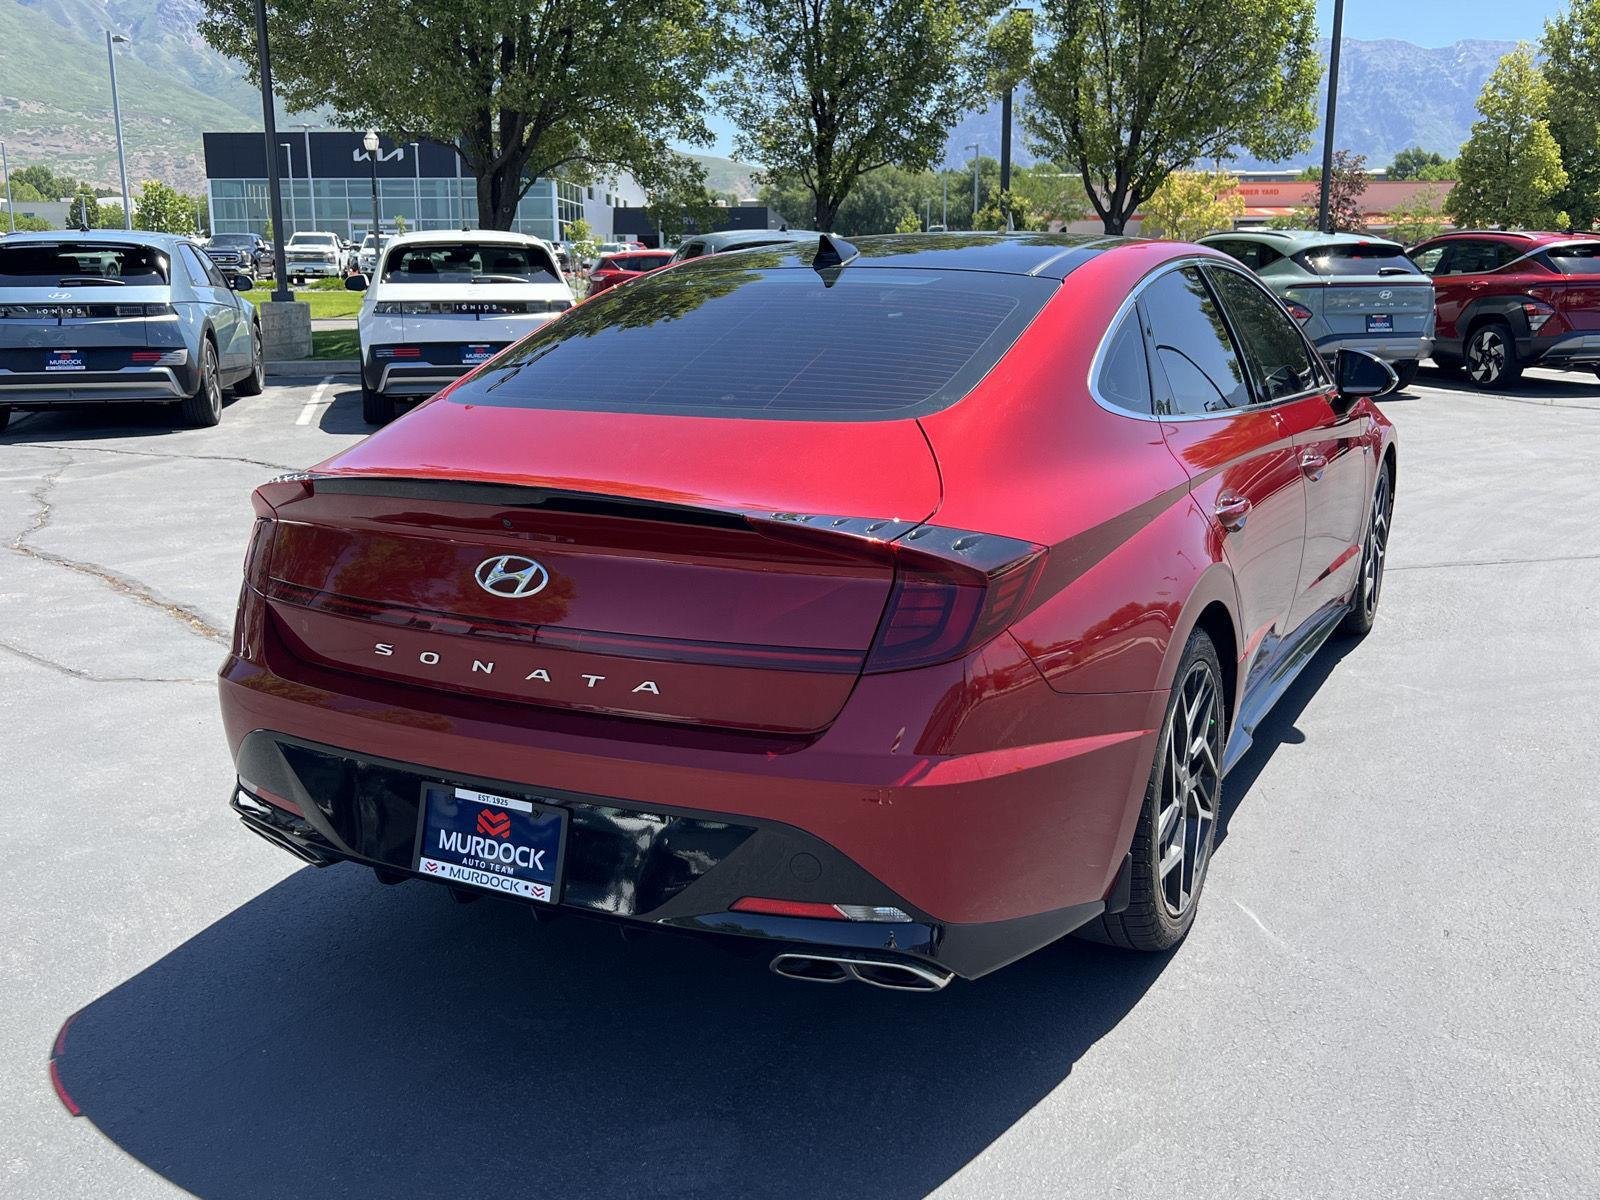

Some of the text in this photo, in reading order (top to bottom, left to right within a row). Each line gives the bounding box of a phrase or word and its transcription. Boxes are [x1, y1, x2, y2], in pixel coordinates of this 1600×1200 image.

[374, 643, 661, 695] SONATA
[477, 794, 509, 806] EST. 1925
[438, 829, 546, 871] MURDOCK
[462, 857, 514, 875] AUTO TEAM
[448, 867, 521, 893] MURDOCK
